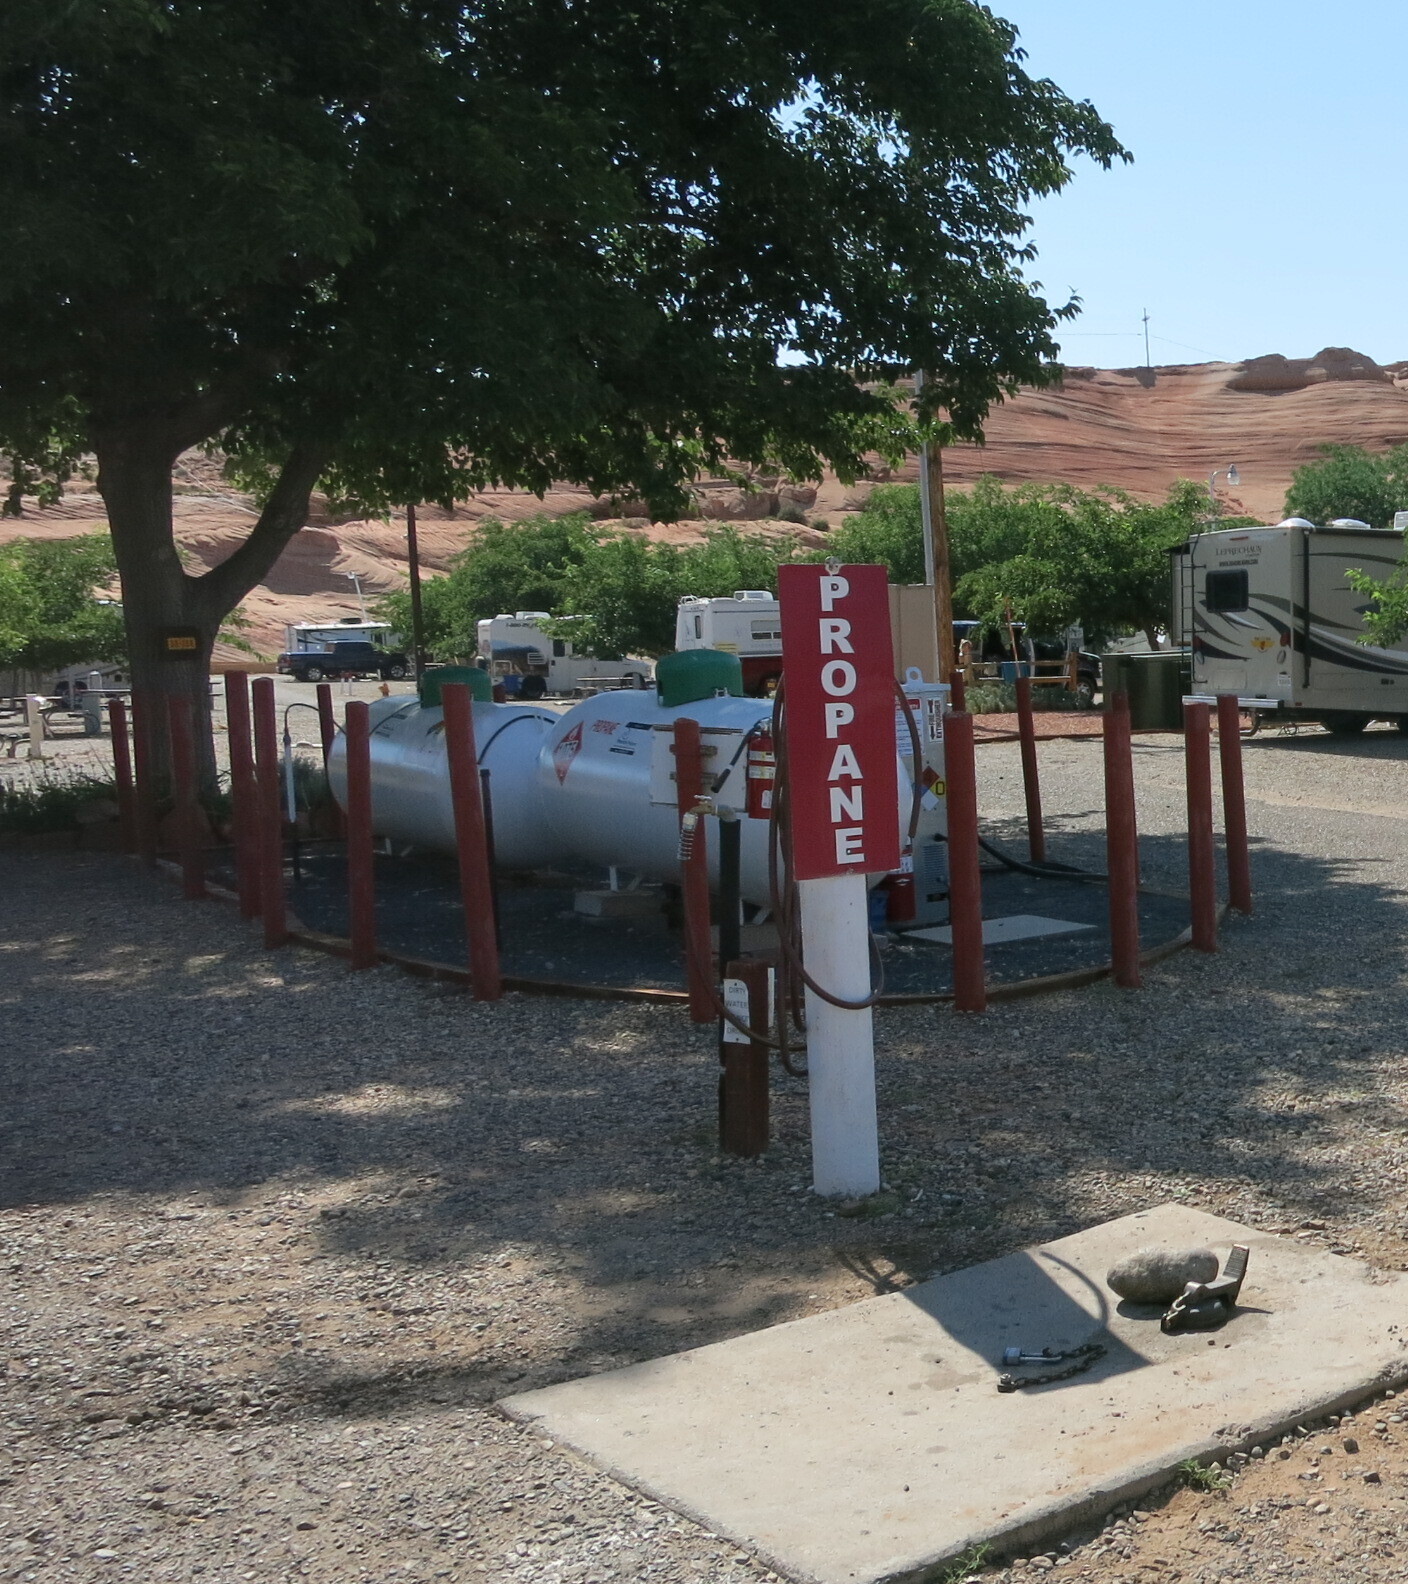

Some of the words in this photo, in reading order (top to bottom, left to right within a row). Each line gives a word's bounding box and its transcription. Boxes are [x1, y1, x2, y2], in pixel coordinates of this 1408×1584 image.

[1214, 545, 1262, 556] LEPRECHAUN
[818, 575, 866, 865] PROPANE
[935, 700, 943, 739] EXTINGUISHER
